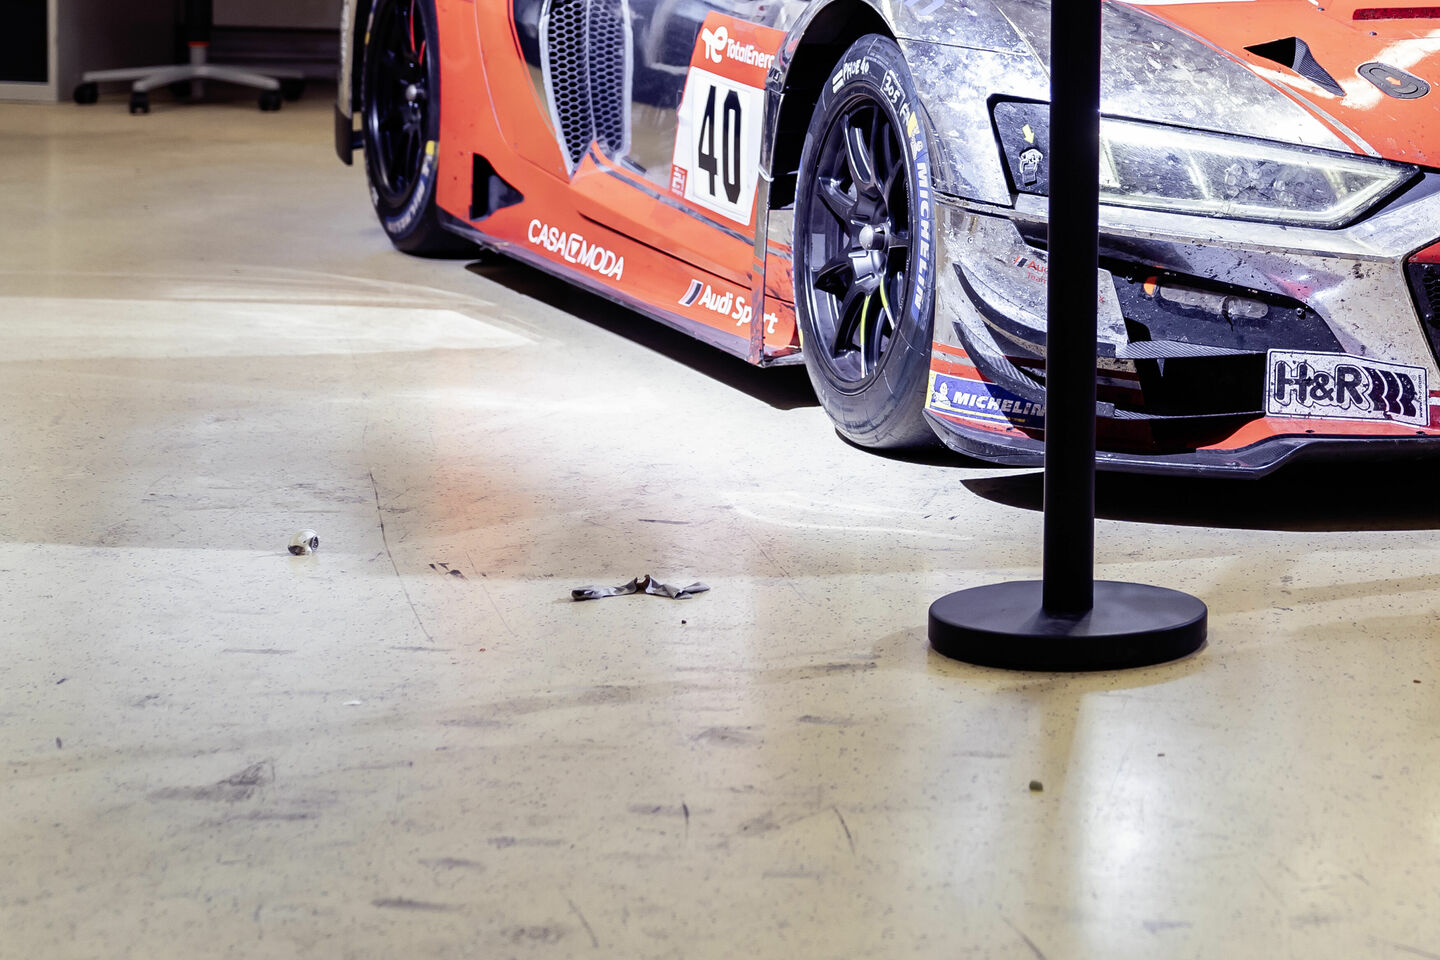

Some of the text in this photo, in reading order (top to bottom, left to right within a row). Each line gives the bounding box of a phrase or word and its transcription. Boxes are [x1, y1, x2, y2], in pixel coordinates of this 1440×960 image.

[883, 76, 900, 103] 305
[698, 84, 742, 205] 40
[914, 162, 930, 310] MICHELIN
[699, 285, 733, 316] Audi
[953, 391, 1045, 417] MICHELIN
[1275, 360, 1368, 409] H&R
